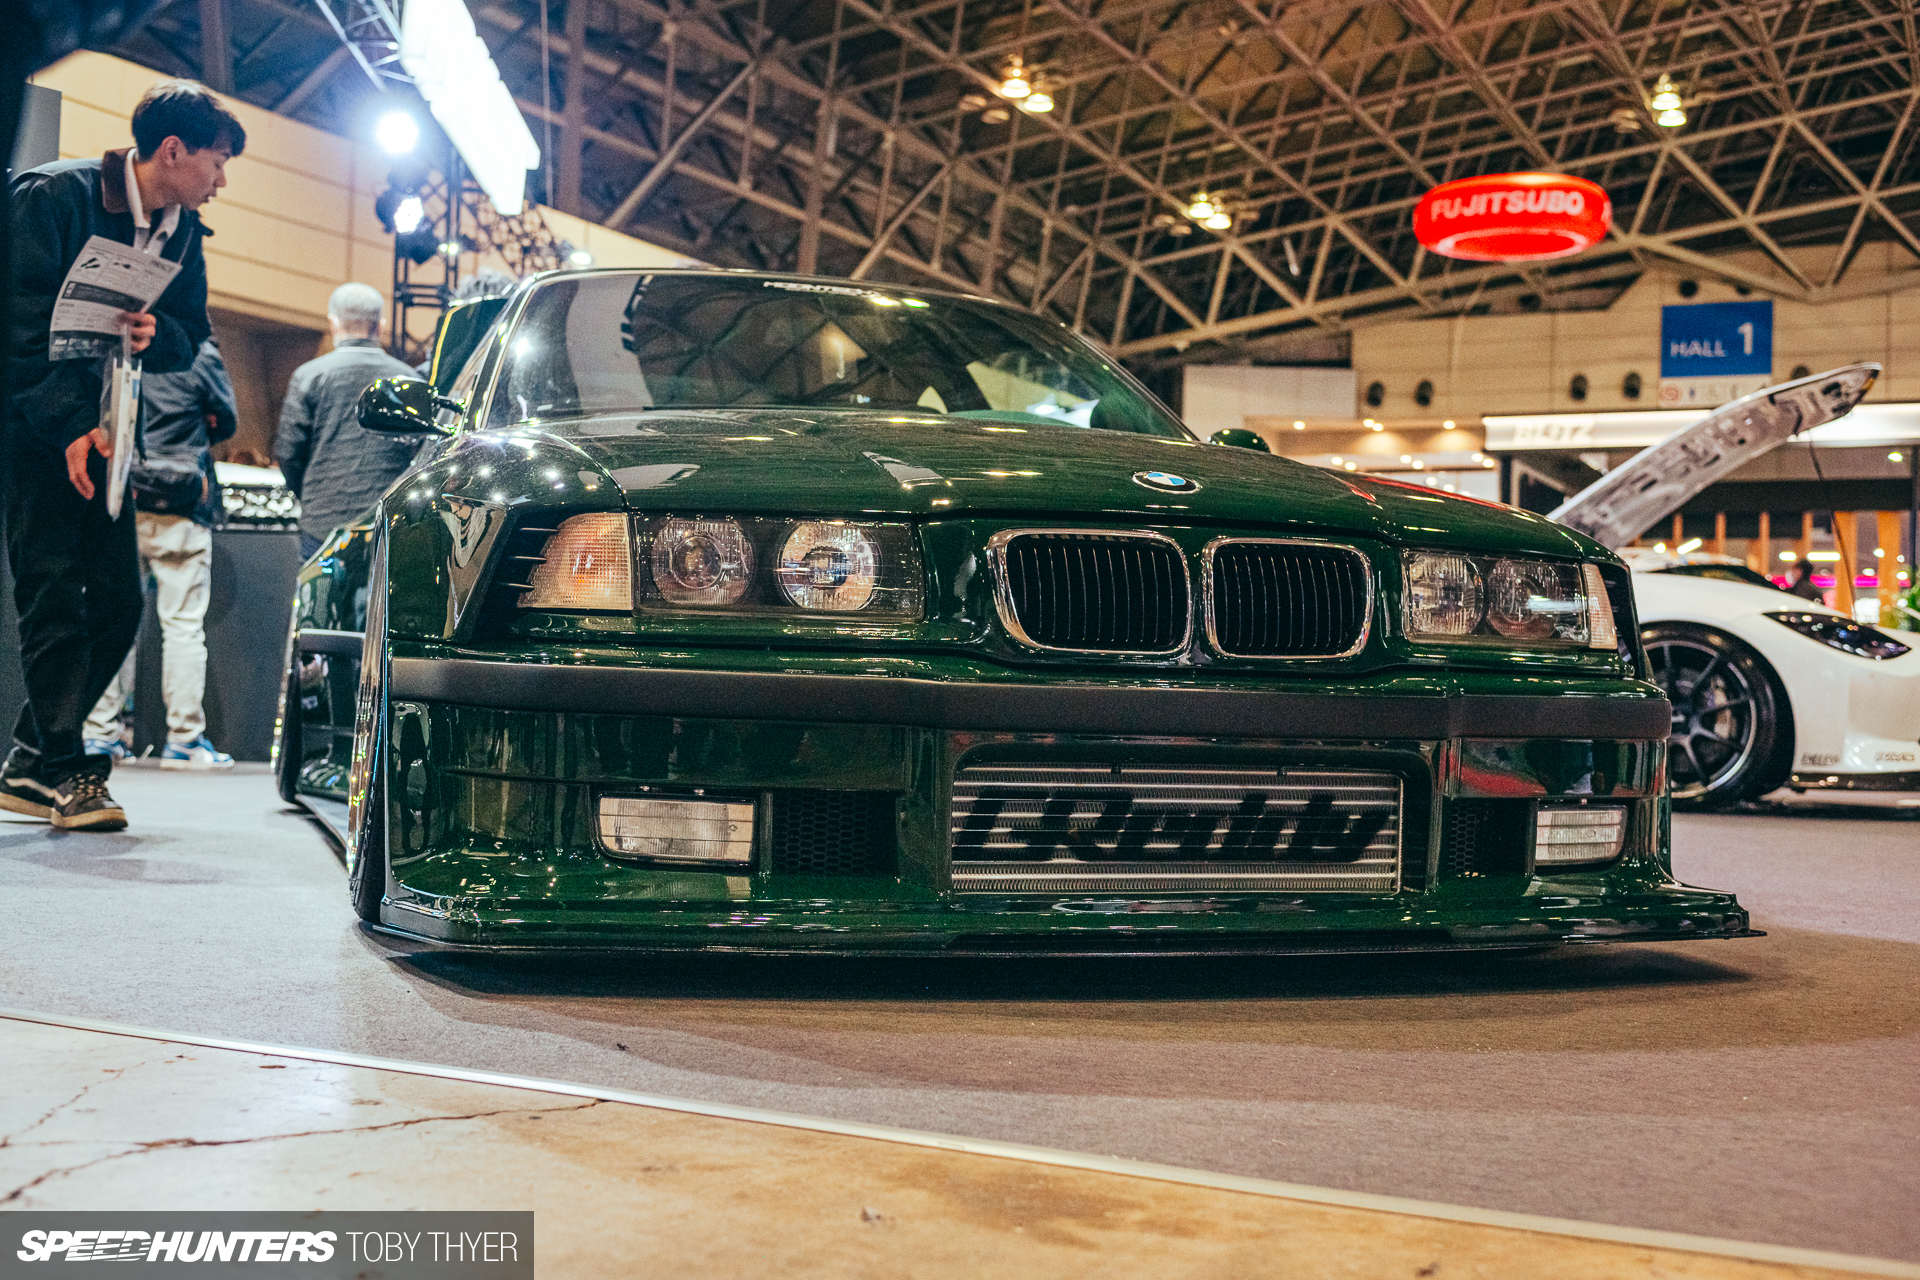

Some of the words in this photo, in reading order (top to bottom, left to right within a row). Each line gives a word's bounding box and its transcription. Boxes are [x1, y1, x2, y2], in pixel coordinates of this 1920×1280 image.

[1430, 189, 1586, 221] FUJITSUBO
[1670, 339, 1726, 358] HALL
[1737, 321, 1754, 356] 1
